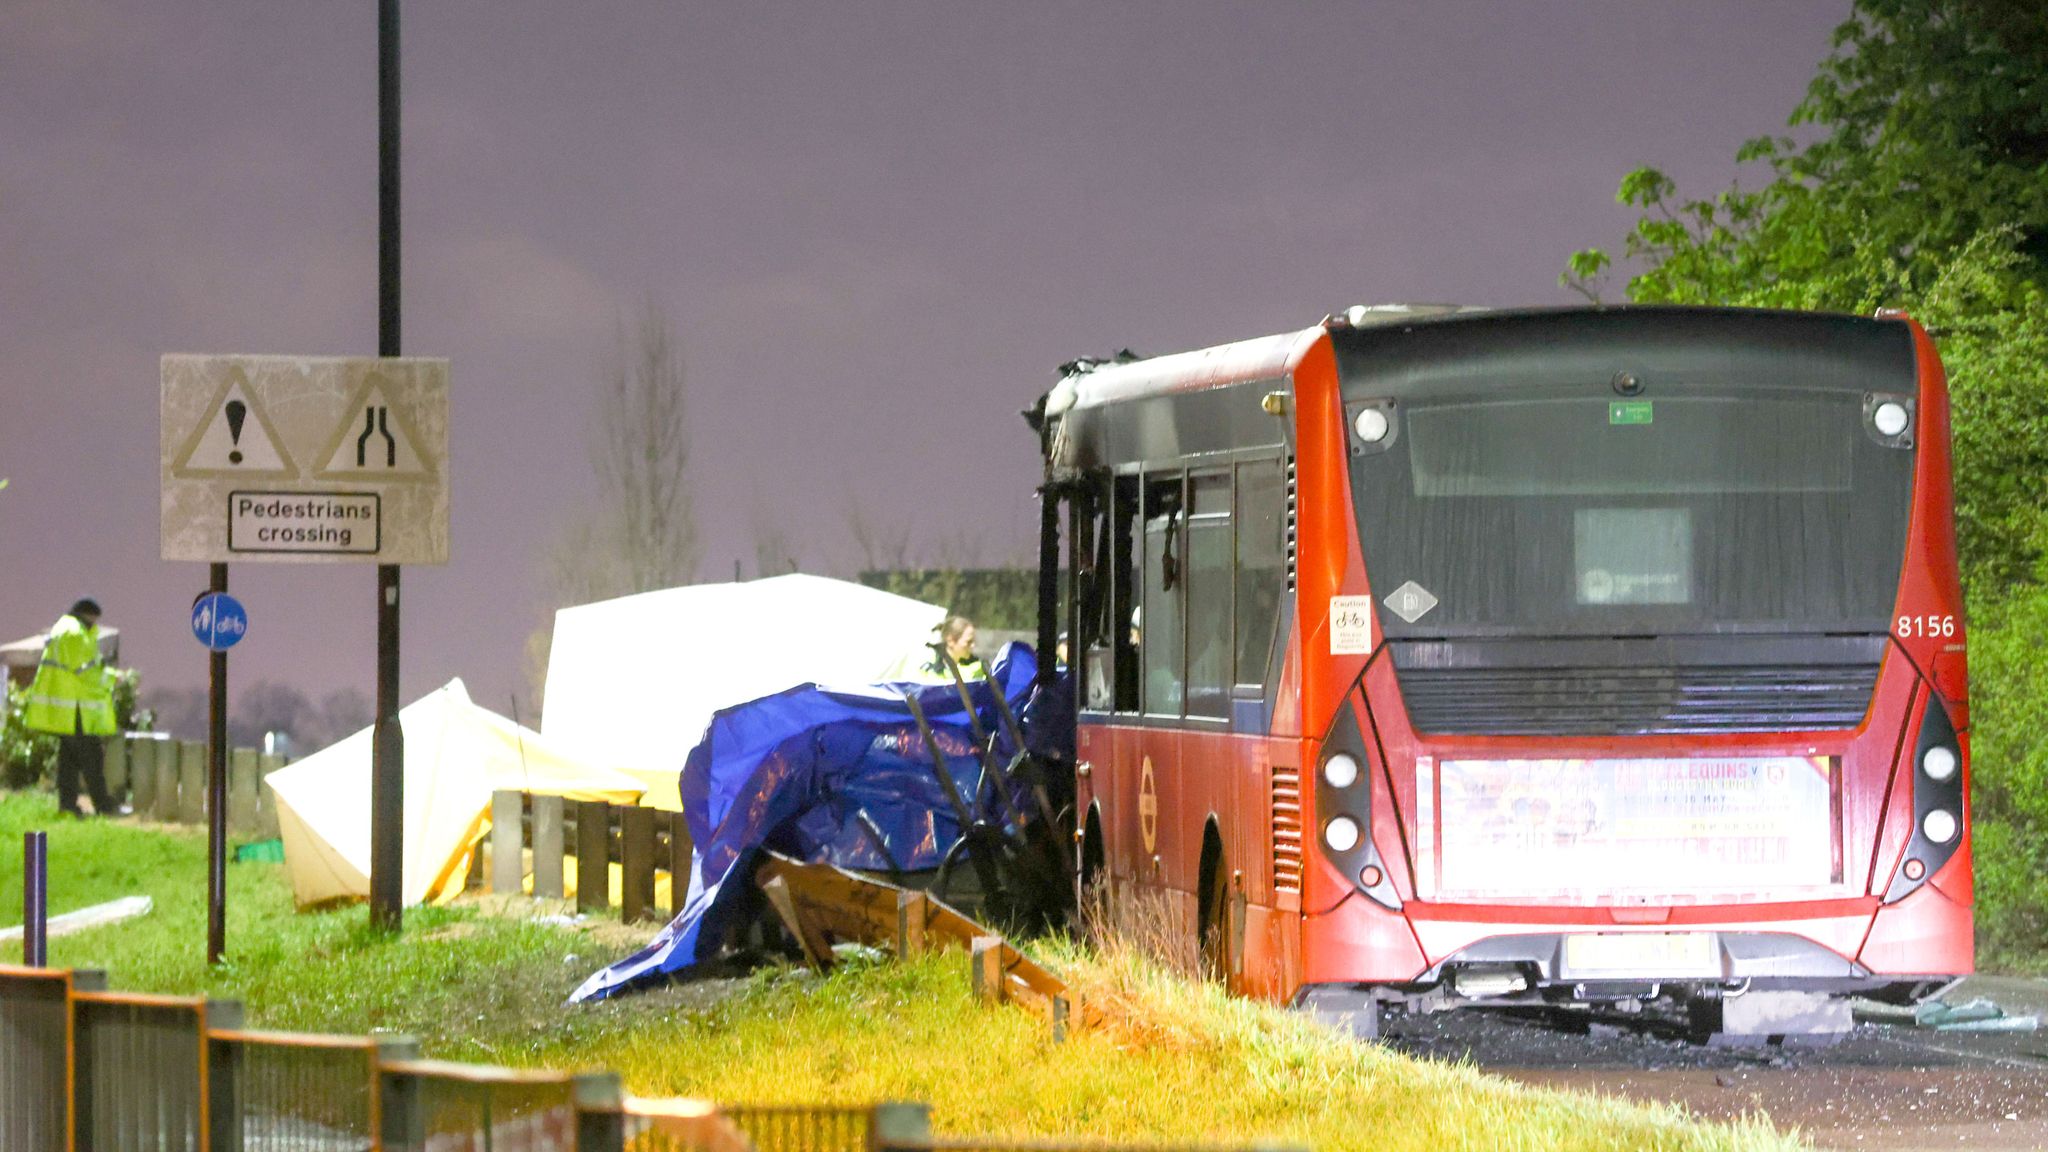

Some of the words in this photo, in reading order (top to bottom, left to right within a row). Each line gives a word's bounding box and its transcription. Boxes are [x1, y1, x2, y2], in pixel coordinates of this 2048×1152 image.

[239, 499, 371, 519] Pedestrians
[258, 523, 352, 546] crossing
[1897, 615, 1955, 638] 8156
